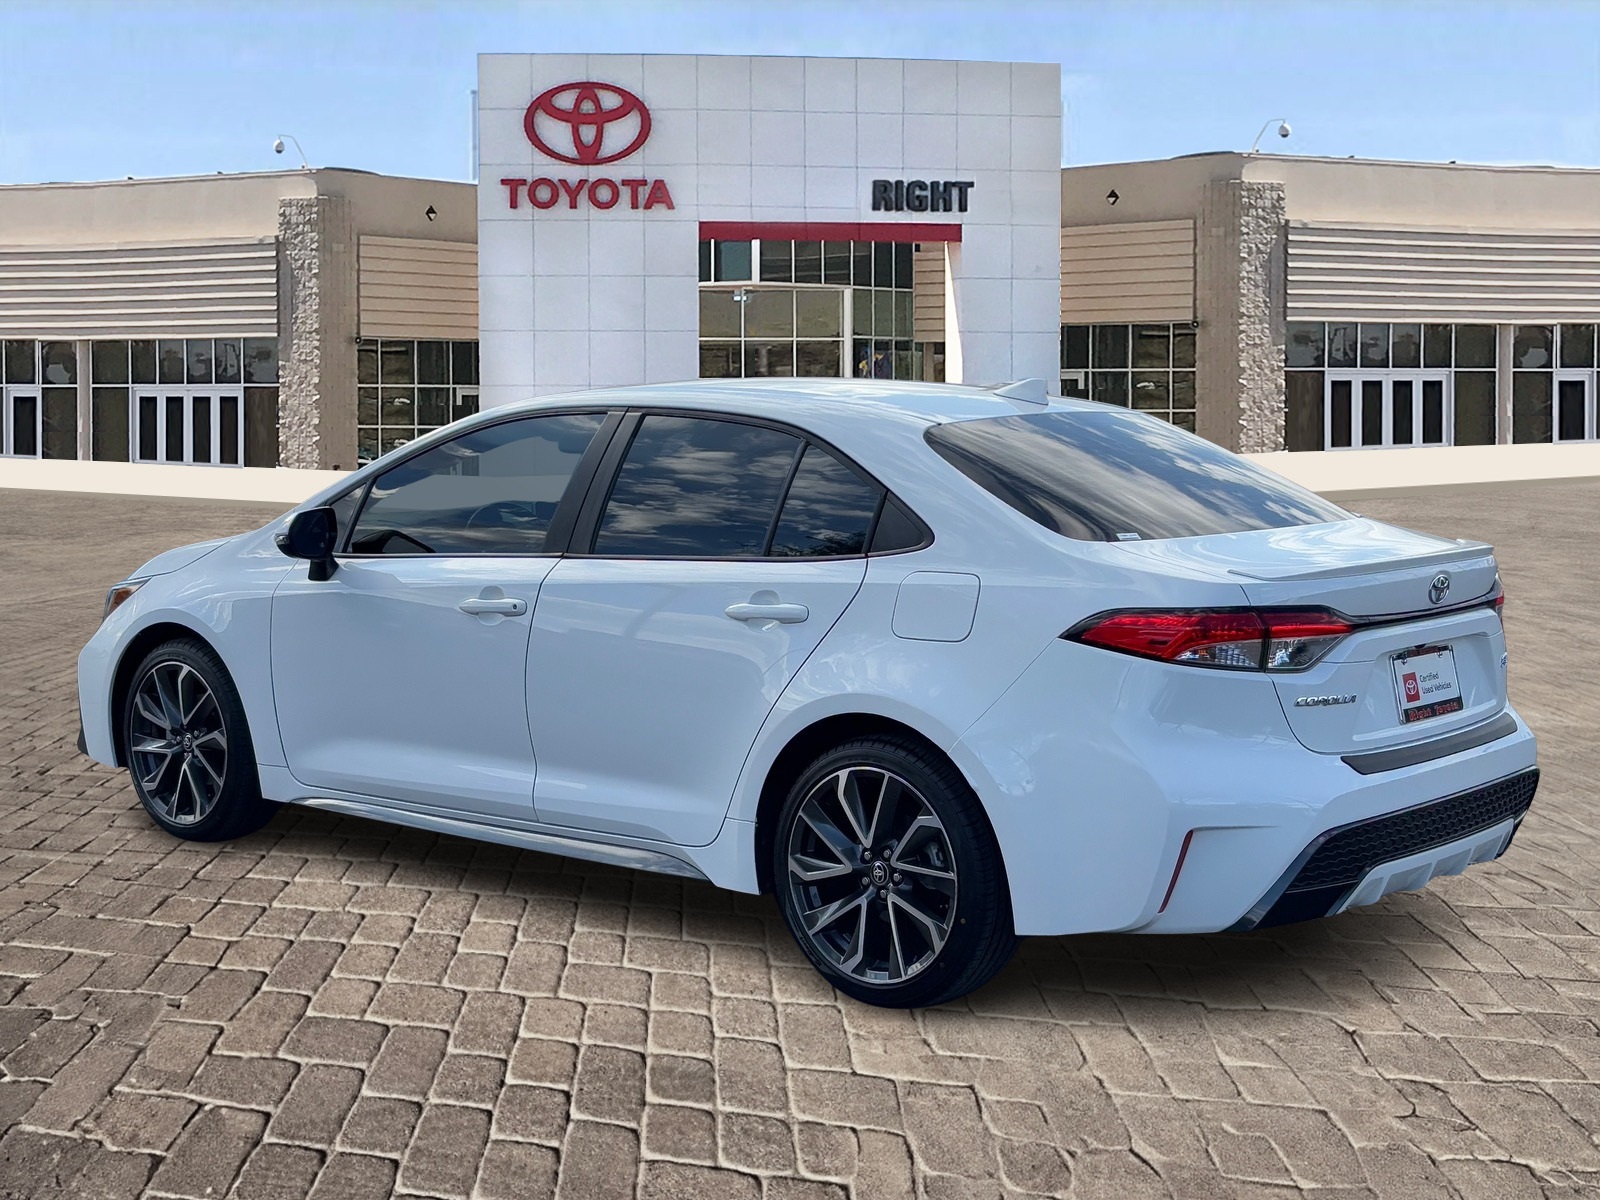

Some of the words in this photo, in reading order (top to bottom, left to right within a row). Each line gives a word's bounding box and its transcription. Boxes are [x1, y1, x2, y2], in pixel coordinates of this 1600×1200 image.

[500, 177, 675, 210] TOYOTA
[872, 179, 975, 212] RIGHT
[1420, 671, 1439, 682] Certified
[1422, 685, 1433, 694] Used
[1434, 681, 1452, 692] Vehicles
[1294, 693, 1357, 706] COROLLA
[1408, 708, 1432, 721] Right
[1434, 701, 1459, 715] Toyota
